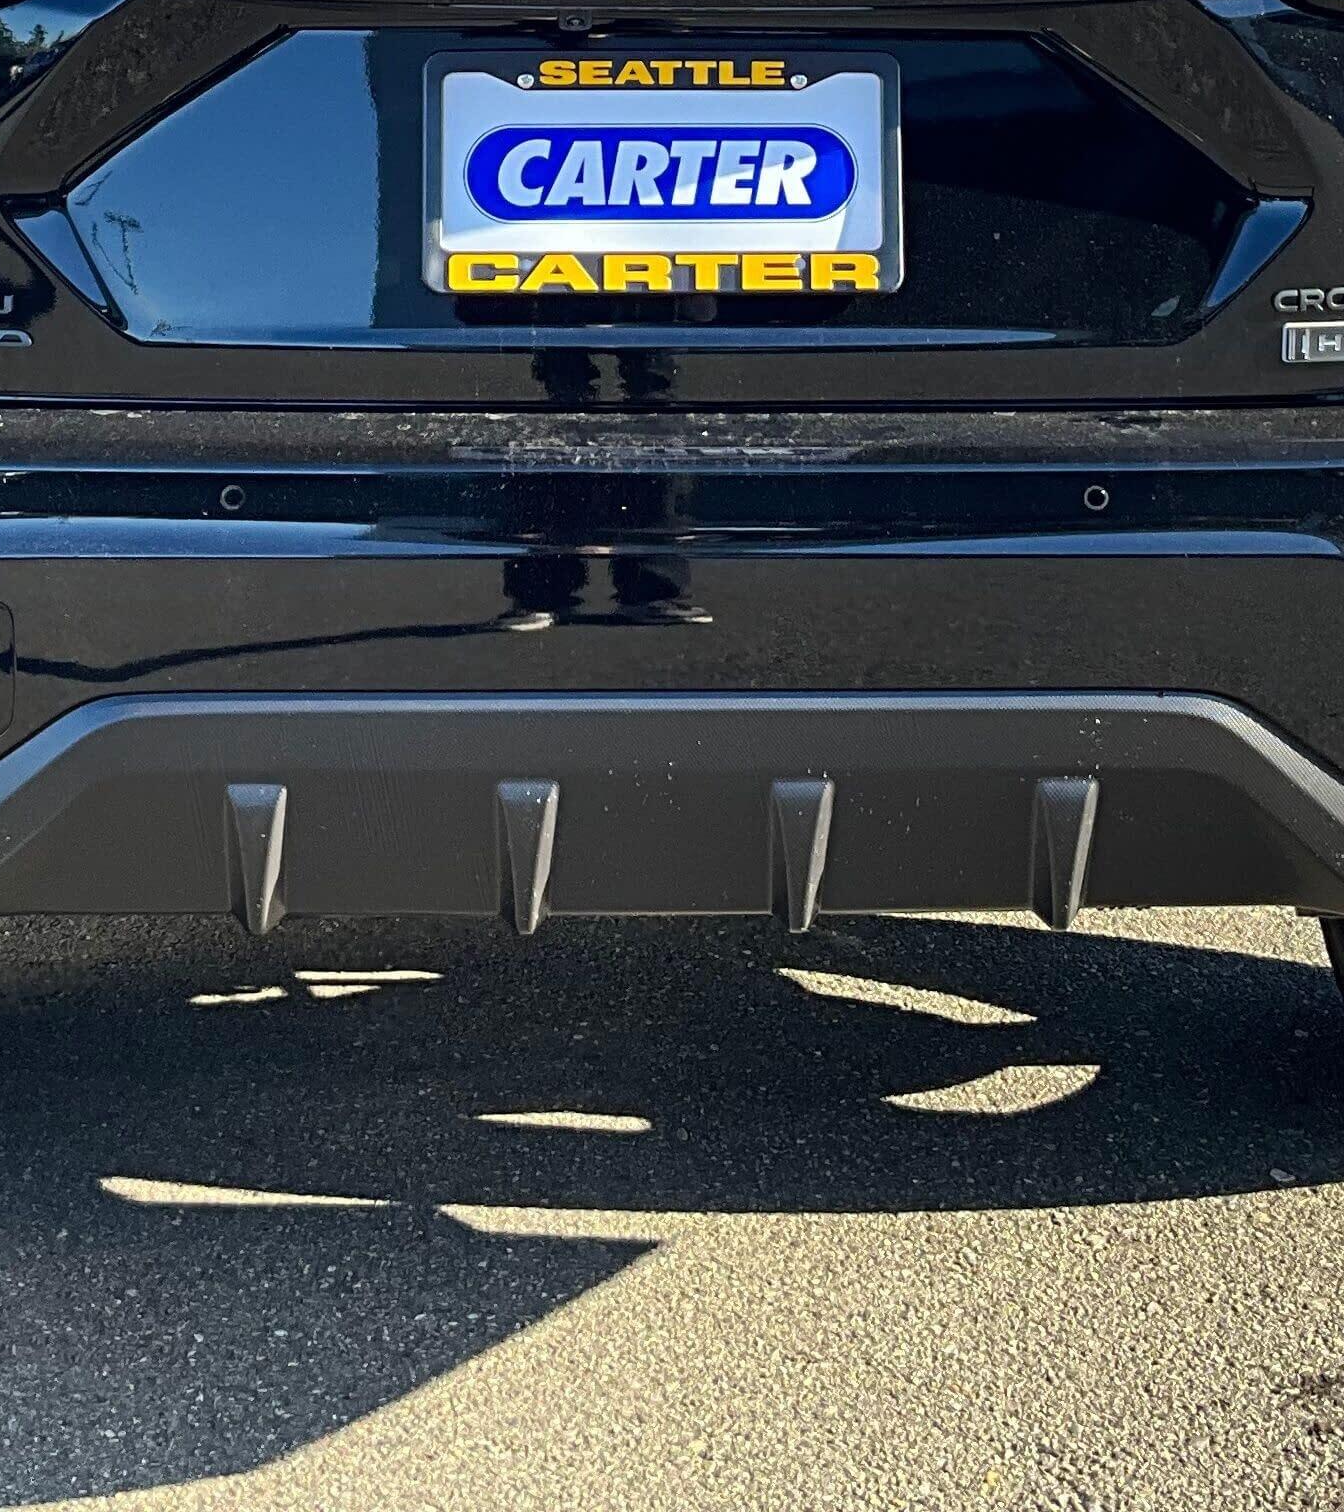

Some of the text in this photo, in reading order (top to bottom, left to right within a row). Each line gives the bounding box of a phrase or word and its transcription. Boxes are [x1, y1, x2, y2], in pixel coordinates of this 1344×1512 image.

[539, 60, 786, 86] SEATTLE
[497, 138, 817, 208] CARTER
[447, 252, 880, 292] CARTER
